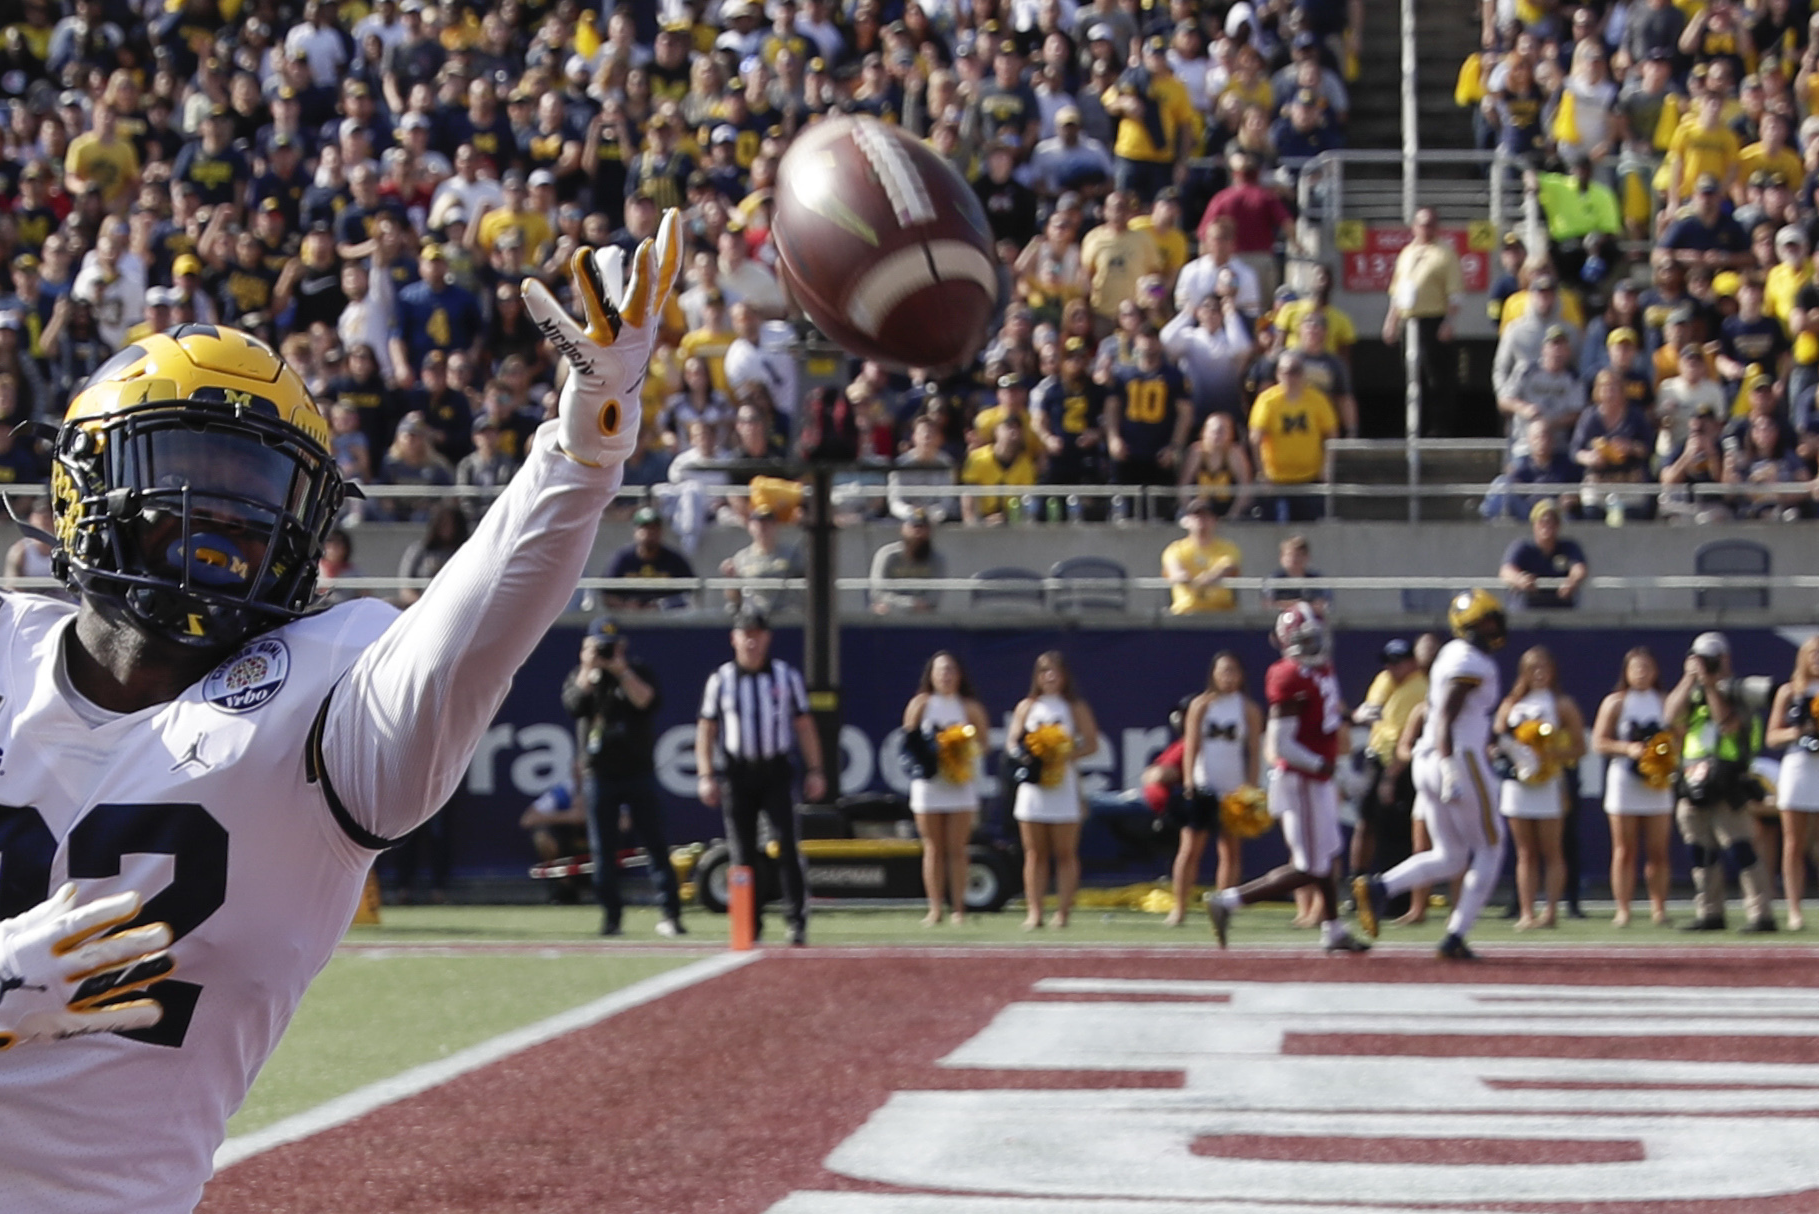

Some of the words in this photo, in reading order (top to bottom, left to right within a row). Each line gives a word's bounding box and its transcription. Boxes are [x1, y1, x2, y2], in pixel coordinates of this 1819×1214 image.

[224, 389, 252, 407] M
[1125, 379, 1169, 424] 10
[225, 687, 269, 708] Vrbo
